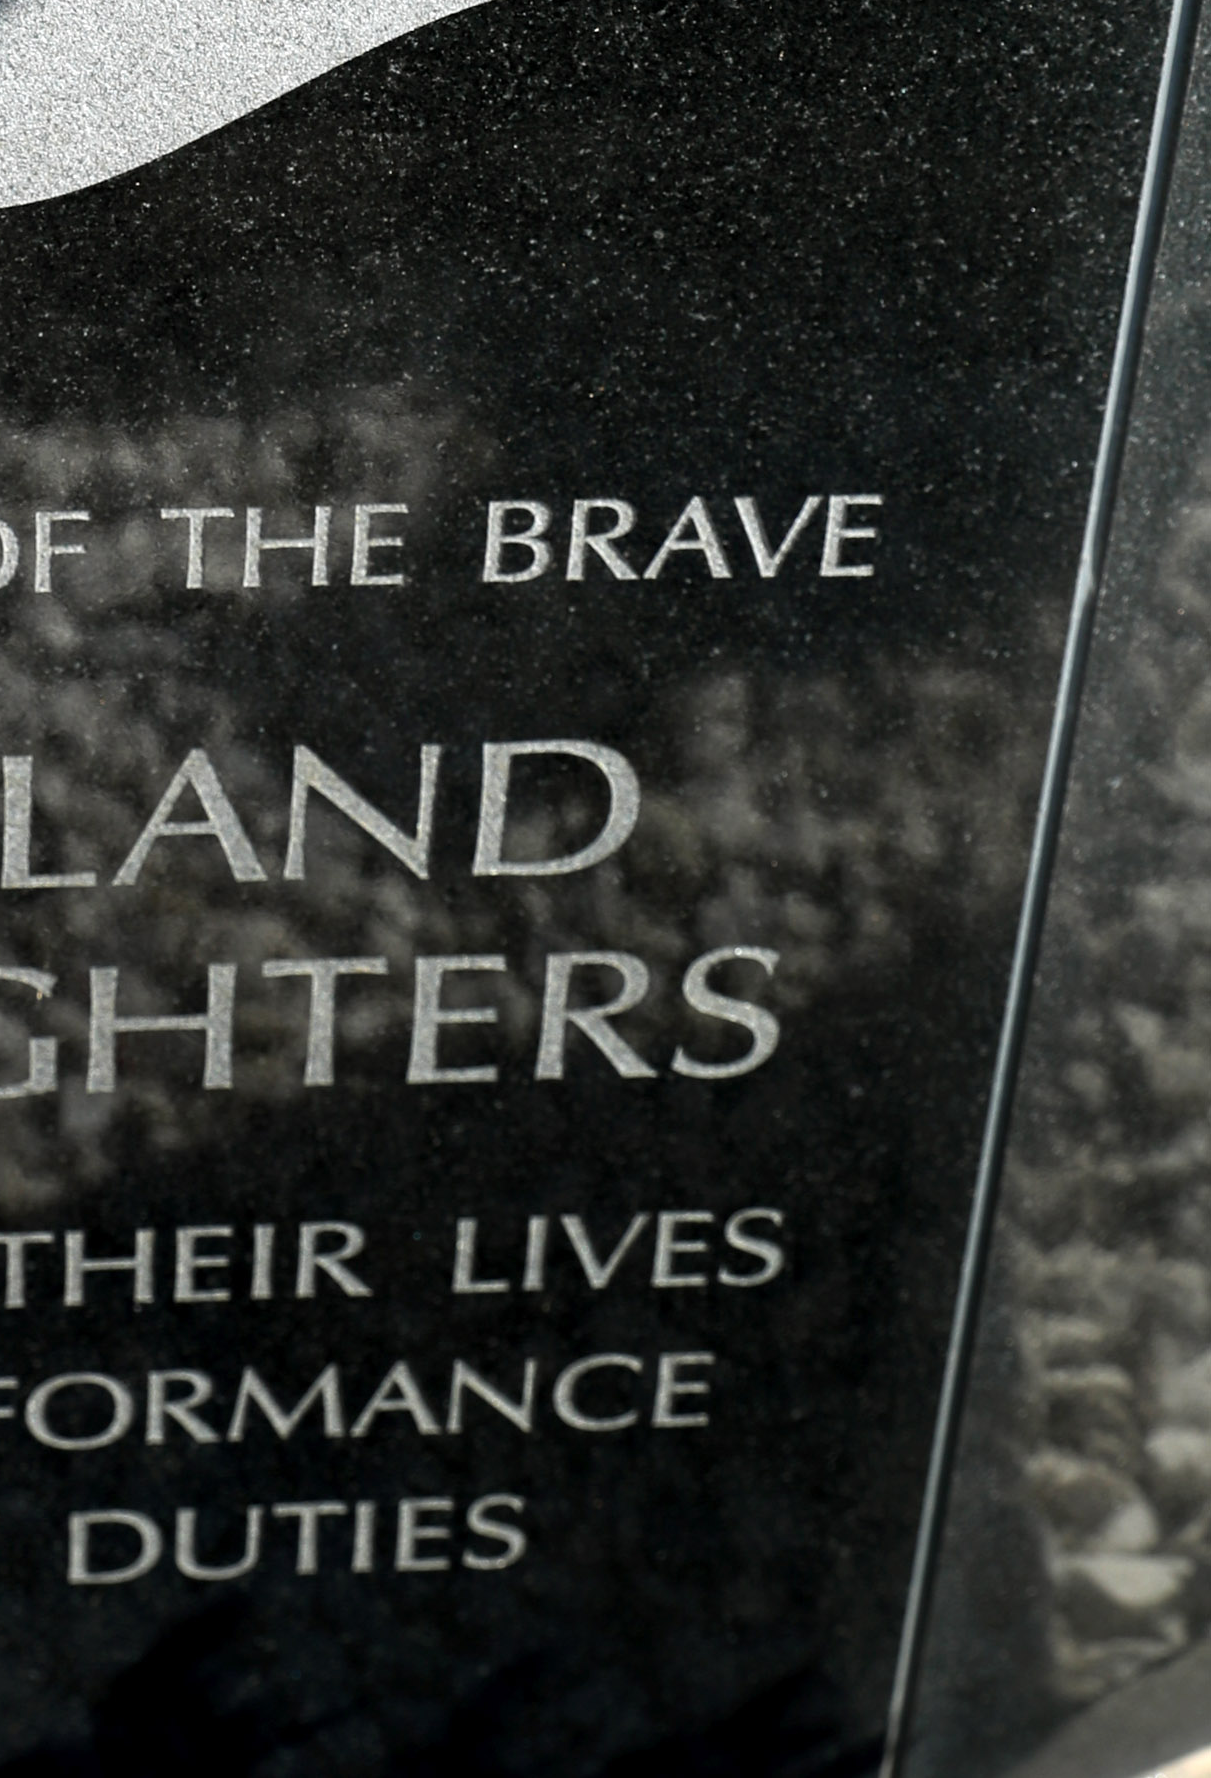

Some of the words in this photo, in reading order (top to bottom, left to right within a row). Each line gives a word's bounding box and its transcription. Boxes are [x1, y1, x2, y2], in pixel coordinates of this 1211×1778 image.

[160, 502, 409, 589] THE
[481, 494, 884, 583] BRAVE
[452, 1207, 786, 1293] LIVES
[67, 1494, 529, 1584] DUTIES
